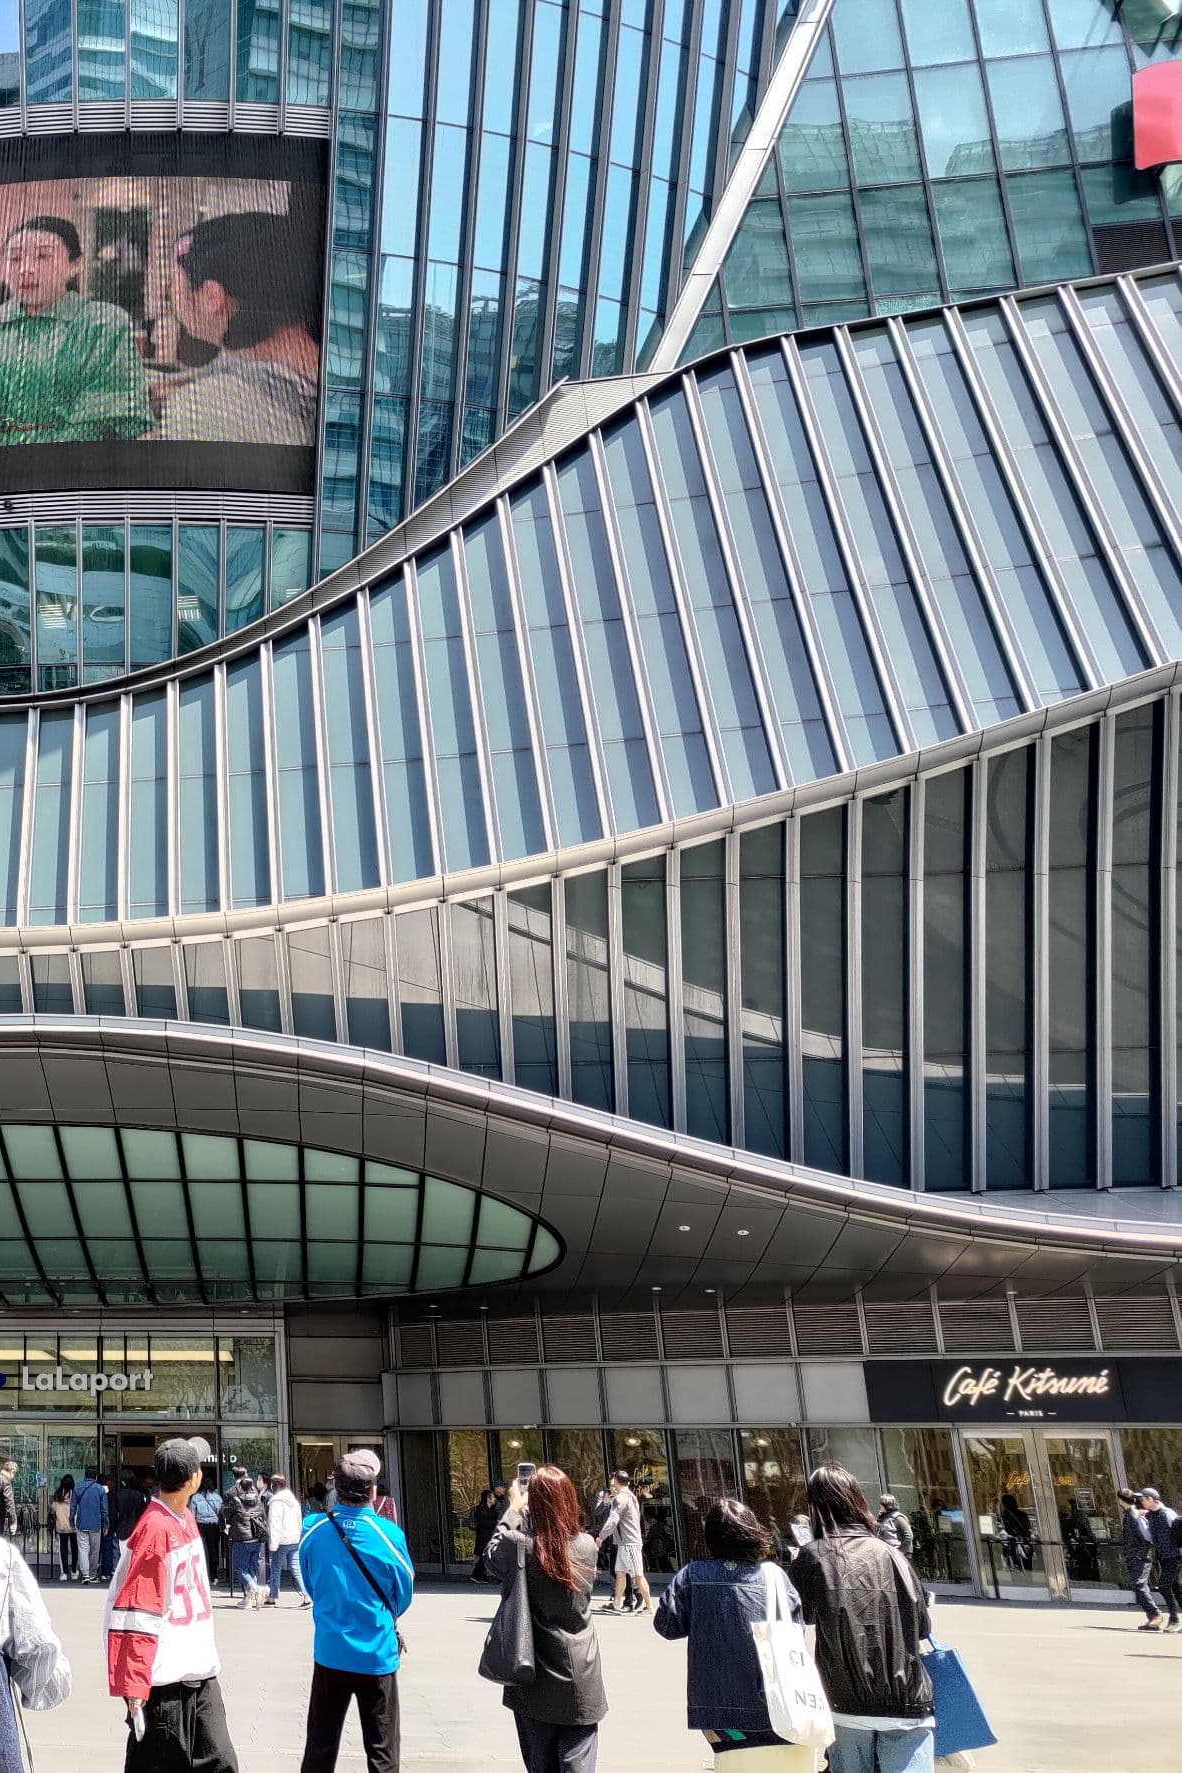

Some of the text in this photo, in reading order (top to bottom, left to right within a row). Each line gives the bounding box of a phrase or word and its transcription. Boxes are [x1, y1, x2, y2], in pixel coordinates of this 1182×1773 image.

[22, 1365, 153, 1397] LaLaport
[943, 1365, 1109, 1407] Café Kitsuné
[1018, 1410, 1043, 1418] PARIS
